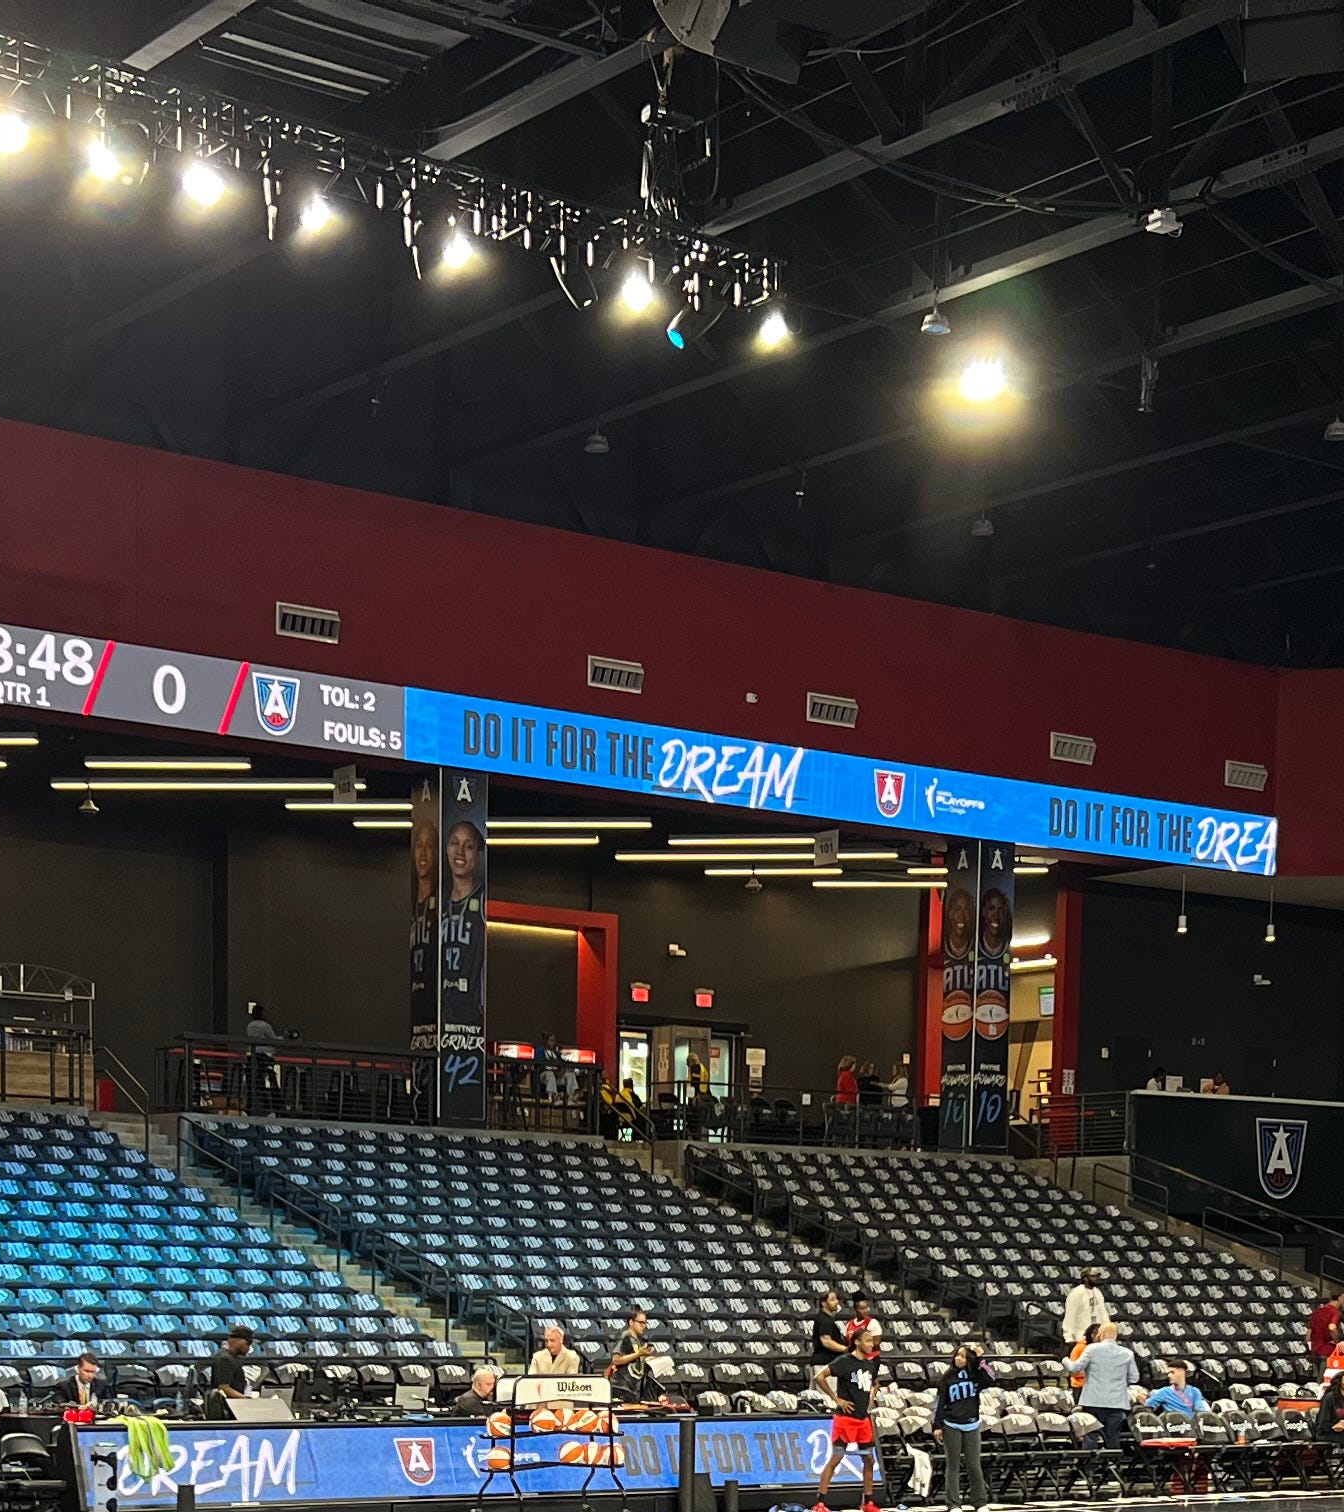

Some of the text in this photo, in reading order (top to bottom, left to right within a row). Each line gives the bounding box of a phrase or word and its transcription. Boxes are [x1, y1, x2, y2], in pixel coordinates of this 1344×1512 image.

[35, 686, 50, 707] 1
[152, 664, 186, 714] 0
[319, 683, 376, 711] TOL: 2
[323, 721, 402, 751] FOULS: 5
[464, 709, 804, 809] DO IT FOR THE DREAM
[935, 795, 985, 810] PLAYOFFS
[1049, 798, 1077, 838] DO
[1085, 804, 1104, 843] IT
[1112, 808, 1149, 848] FOR
[1157, 813, 1193, 854] THE
[819, 841, 834, 854] 101
[444, 1024, 482, 1033] BRITTNEY
[441, 1035, 485, 1053] GRINER
[443, 1054, 481, 1092] 42
[975, 1092, 1002, 1130] 10
[556, 1381, 593, 1392] Wilson
[949, 1380, 976, 1402] ATL
[623, 1434, 656, 1477] DO
[698, 1433, 752, 1474] FOR
[759, 1432, 807, 1471] THE
